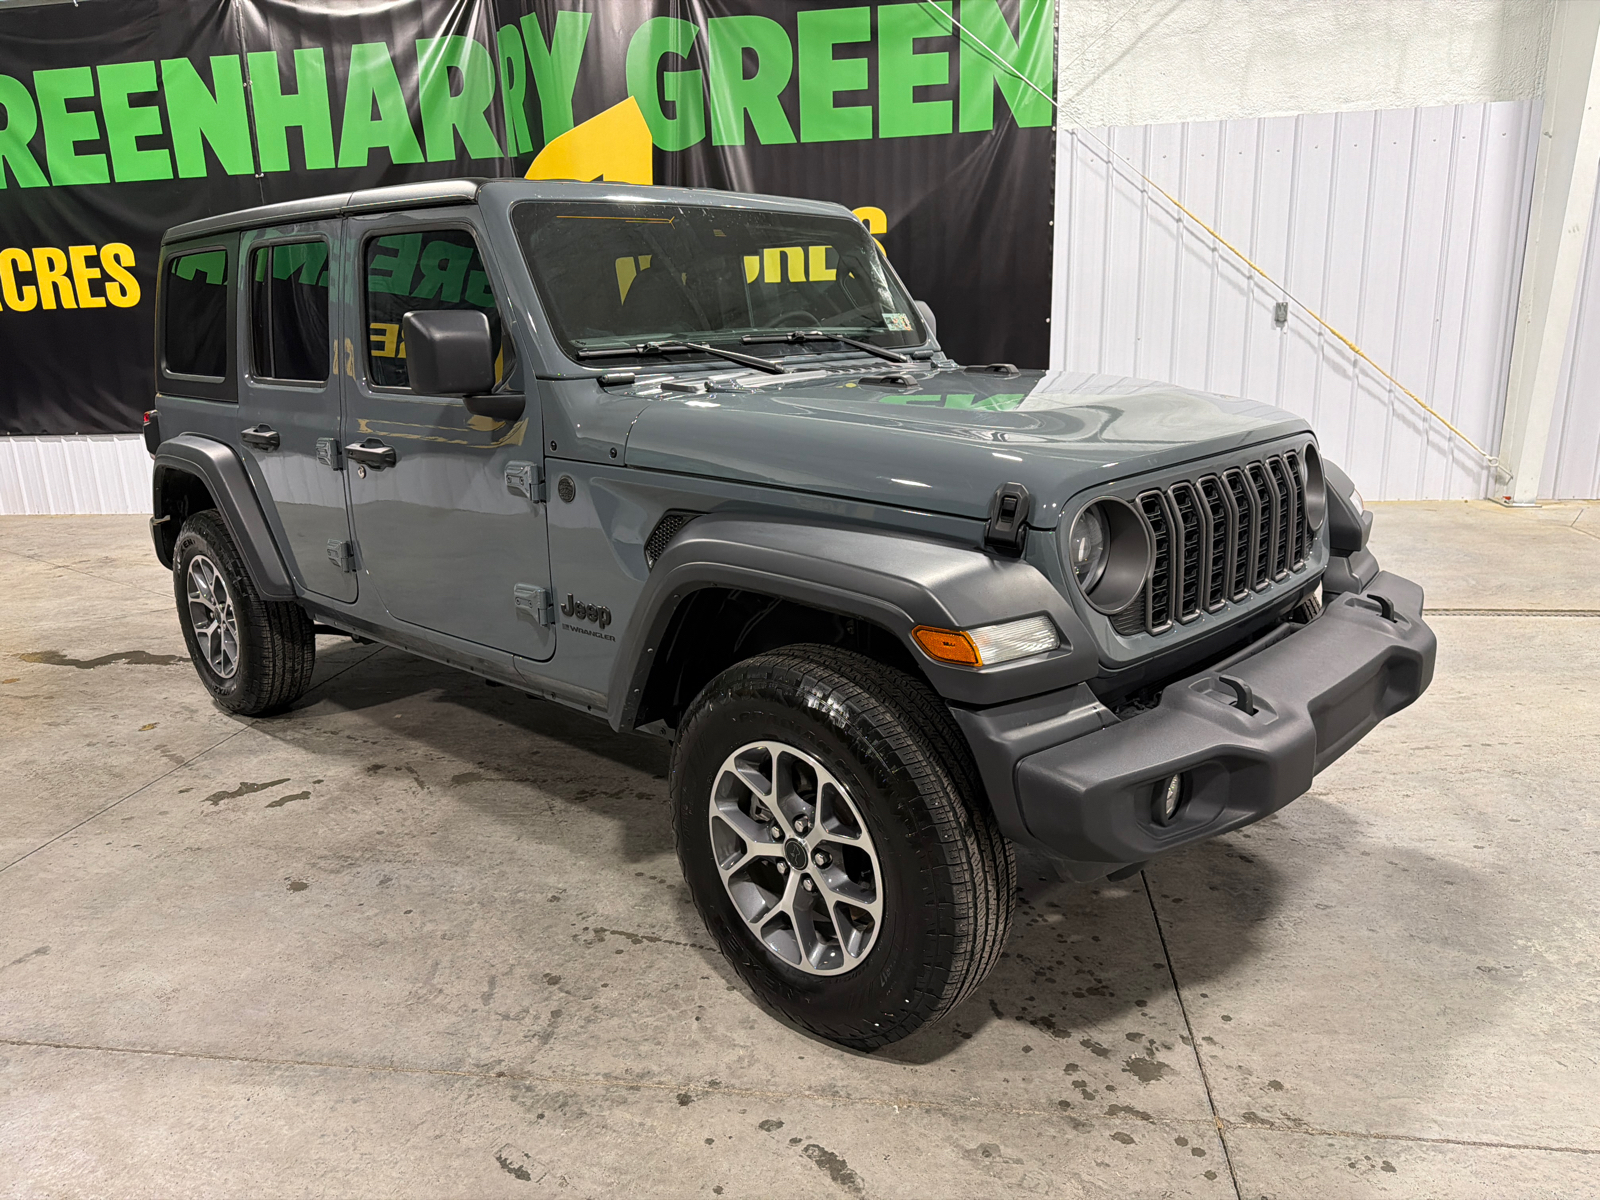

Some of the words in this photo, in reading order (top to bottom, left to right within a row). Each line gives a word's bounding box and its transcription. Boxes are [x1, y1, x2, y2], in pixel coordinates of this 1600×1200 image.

[626, 0, 1054, 152] GREEN
[0, 242, 141, 312] CRES
[561, 593, 612, 630] Jeep
[569, 625, 616, 642] WRANGLER
